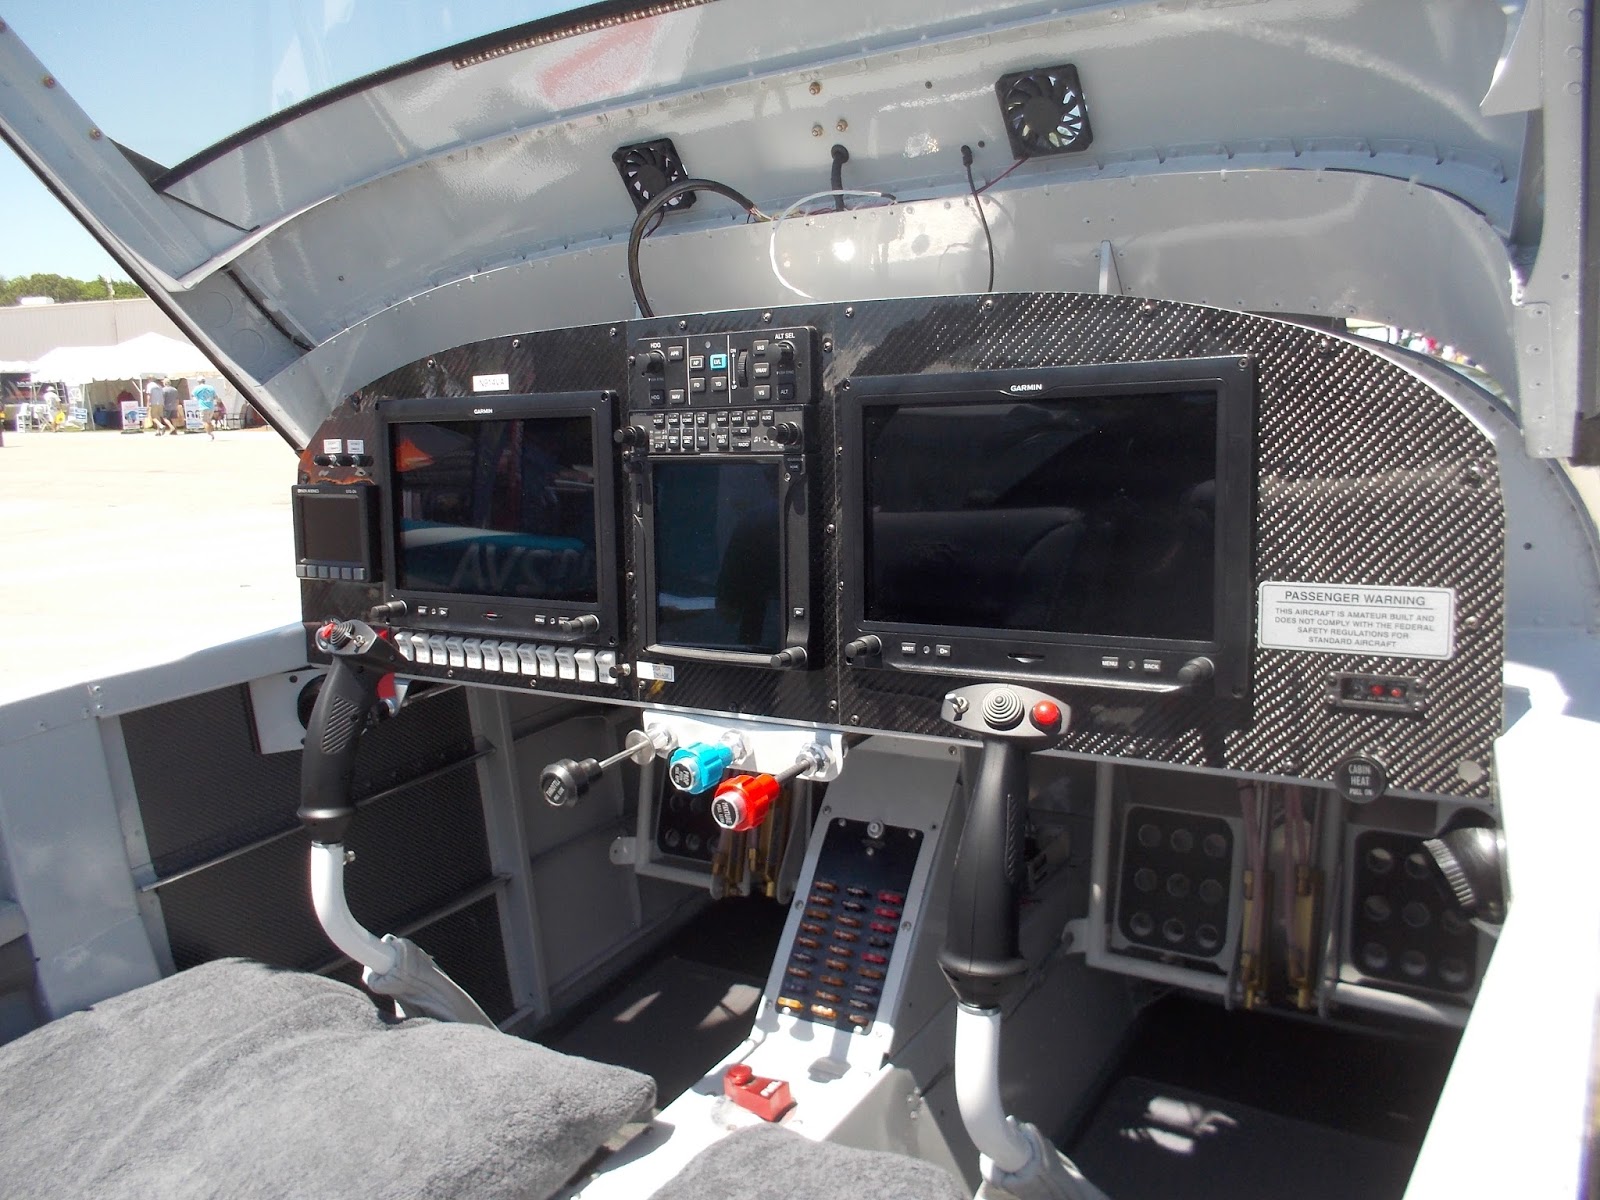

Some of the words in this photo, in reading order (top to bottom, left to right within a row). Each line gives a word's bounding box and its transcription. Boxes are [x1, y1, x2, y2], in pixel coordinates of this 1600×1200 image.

[1285, 591, 1359, 602] PASSENGER
[1364, 594, 1426, 606] WARNING
[1295, 609, 1335, 617] AIRCRAFT
[1347, 611, 1387, 620] AMATEUR
[1395, 623, 1434, 632] FEDERAL
[1330, 629, 1389, 638] REGULATIONS
[1308, 636, 1351, 645] STANDARD
[1354, 639, 1396, 647] AIRCRAFT
[1349, 764, 1371, 774] CABIN
[1350, 776, 1370, 786] HEAT
[721, 802, 732, 824] MIXTURE
